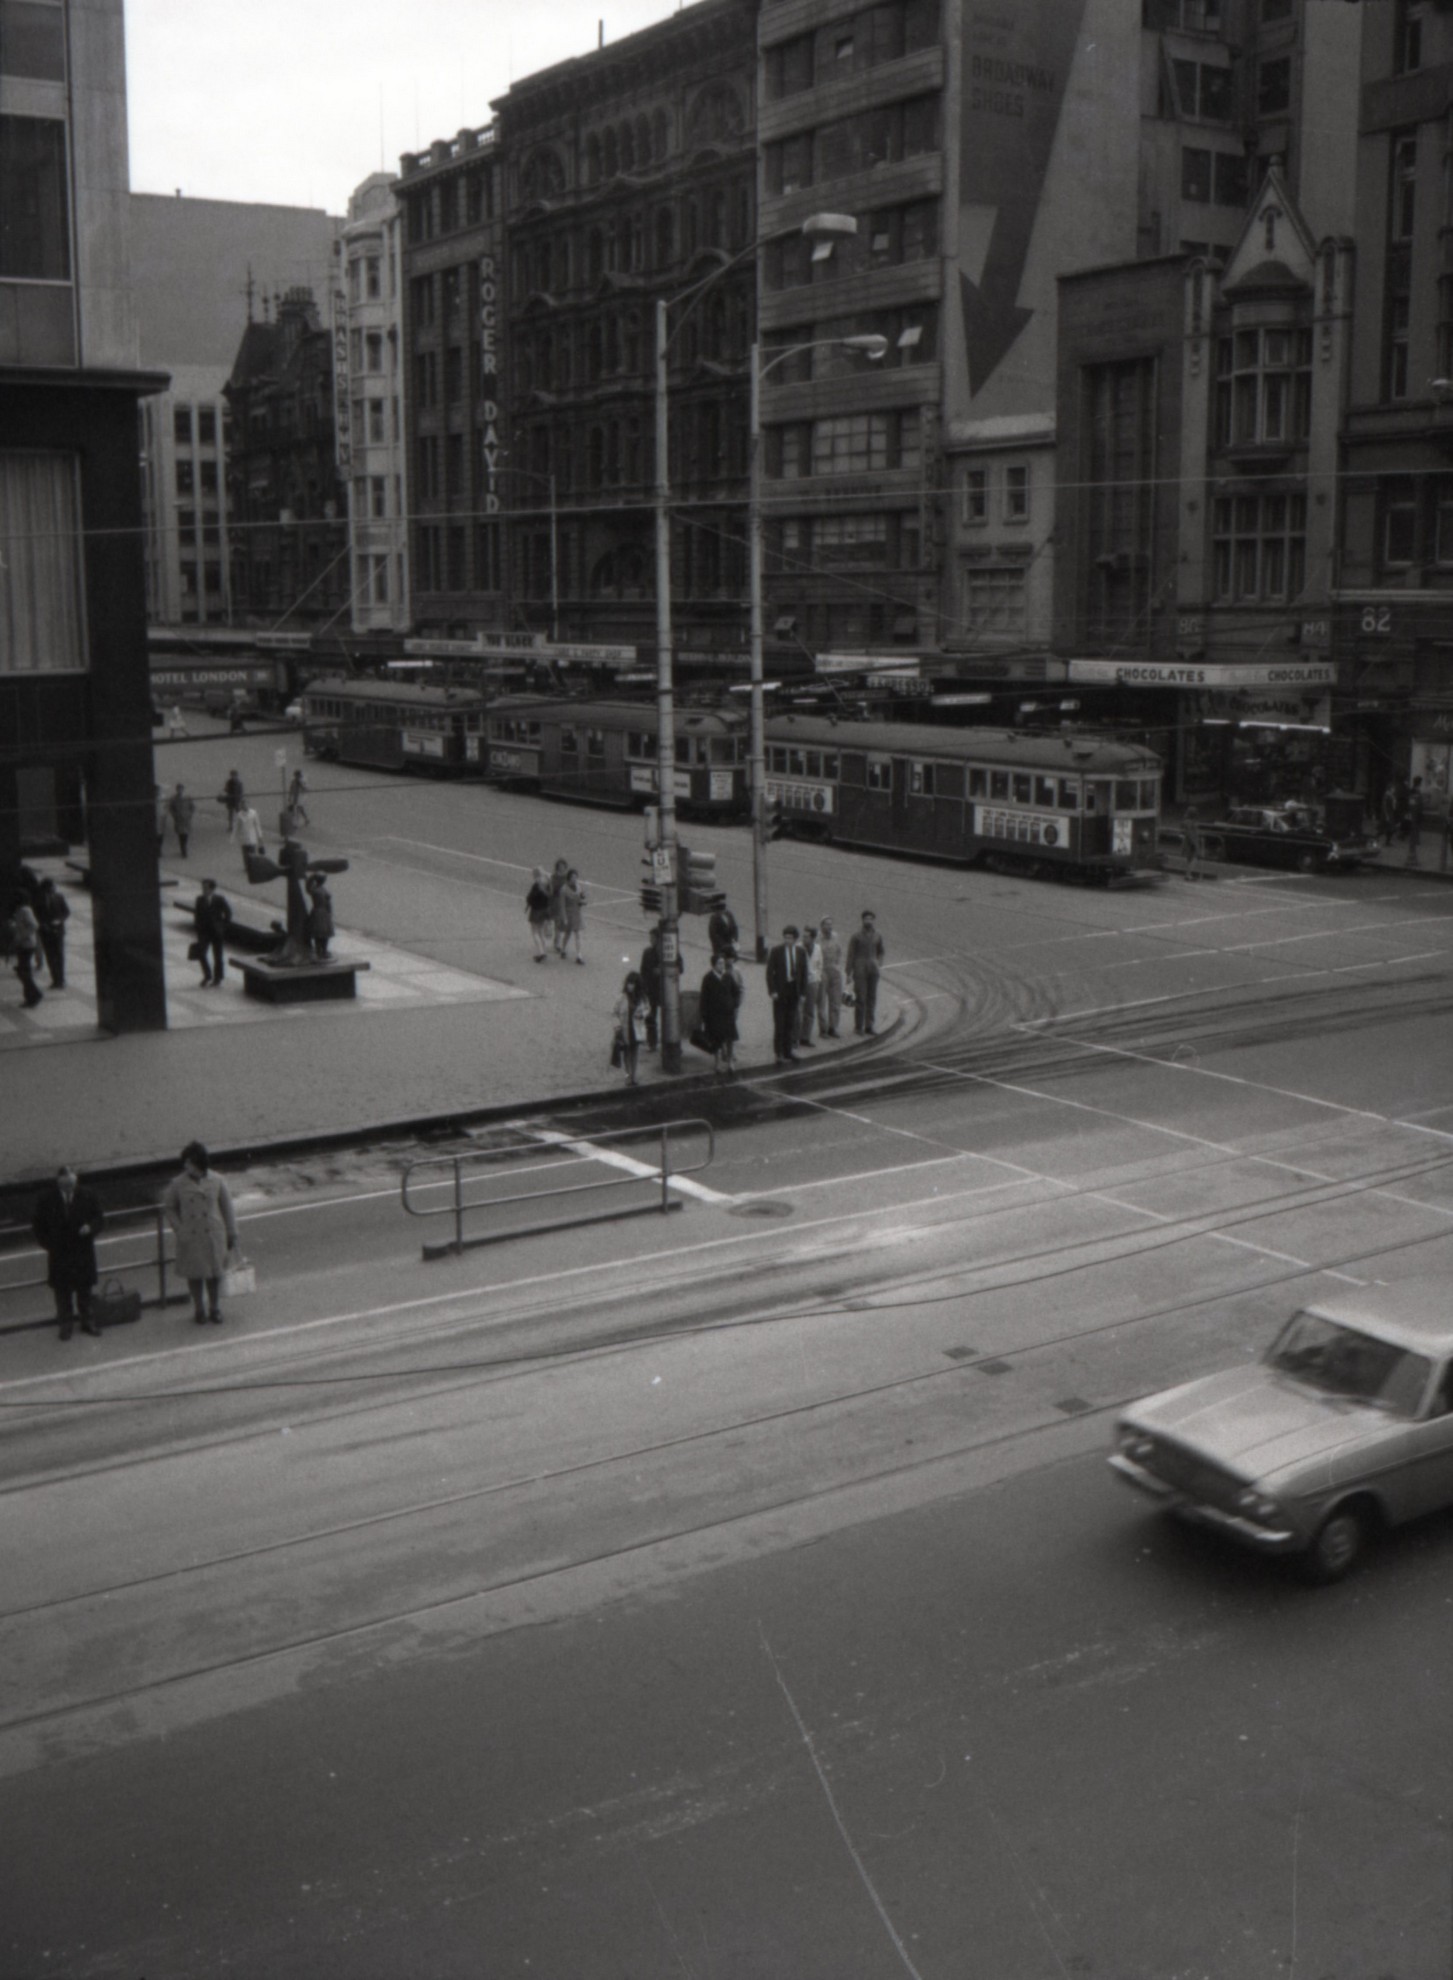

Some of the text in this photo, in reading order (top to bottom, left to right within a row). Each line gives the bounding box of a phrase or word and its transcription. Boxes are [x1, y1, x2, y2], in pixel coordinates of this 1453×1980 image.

[972, 54, 1056, 93] BROADWAY
[972, 86, 1025, 118] SHOES
[481, 257, 499, 514] ROGER DAVID
[1361, 606, 1391, 632] 82
[193, 670, 248, 684] LONDON
[1116, 667, 1205, 683] CHOCOLATES
[1267, 668, 1330, 682] CHOCOLATES
